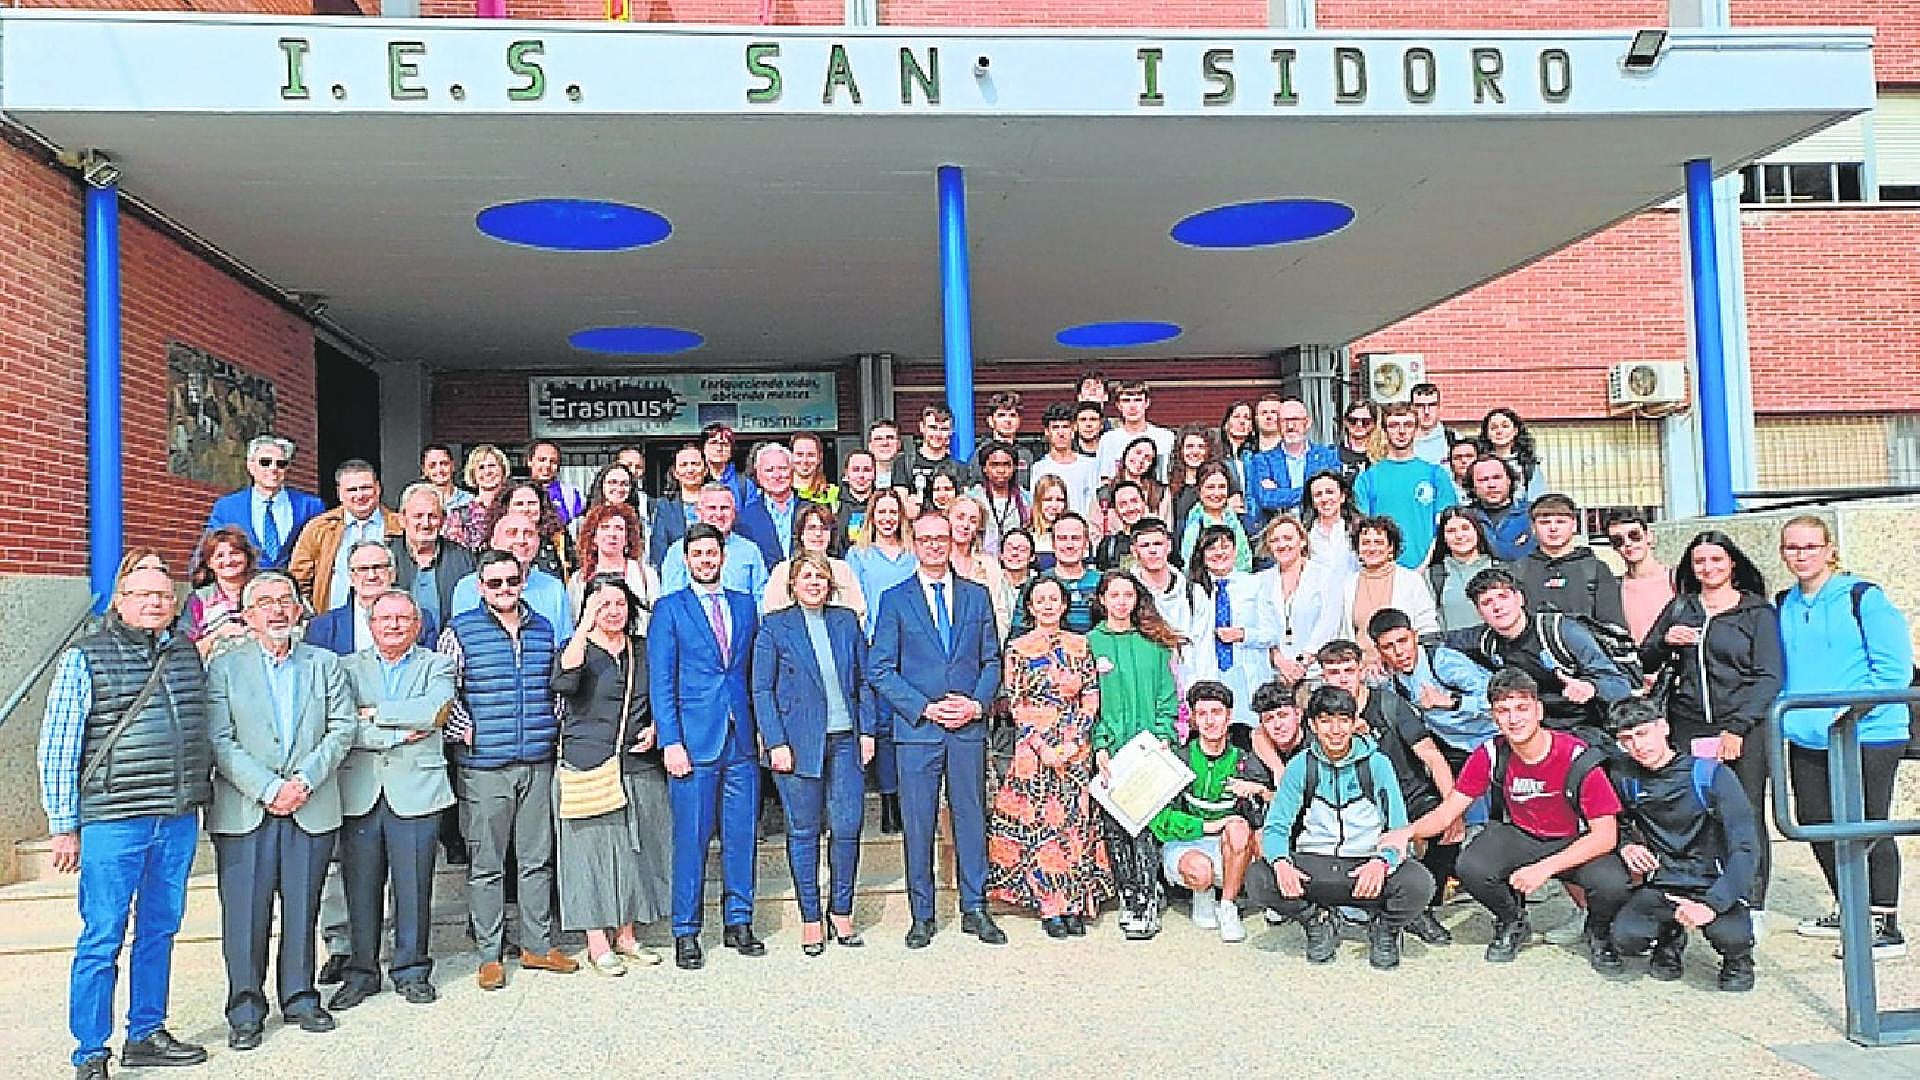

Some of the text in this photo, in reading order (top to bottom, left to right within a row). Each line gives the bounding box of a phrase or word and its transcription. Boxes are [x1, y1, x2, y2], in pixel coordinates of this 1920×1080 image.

[278, 37, 1574, 106] I.E.S. SAN ISIDORO
[551, 397, 676, 419] Erasmus+
[741, 414, 824, 429] Erasmus+
